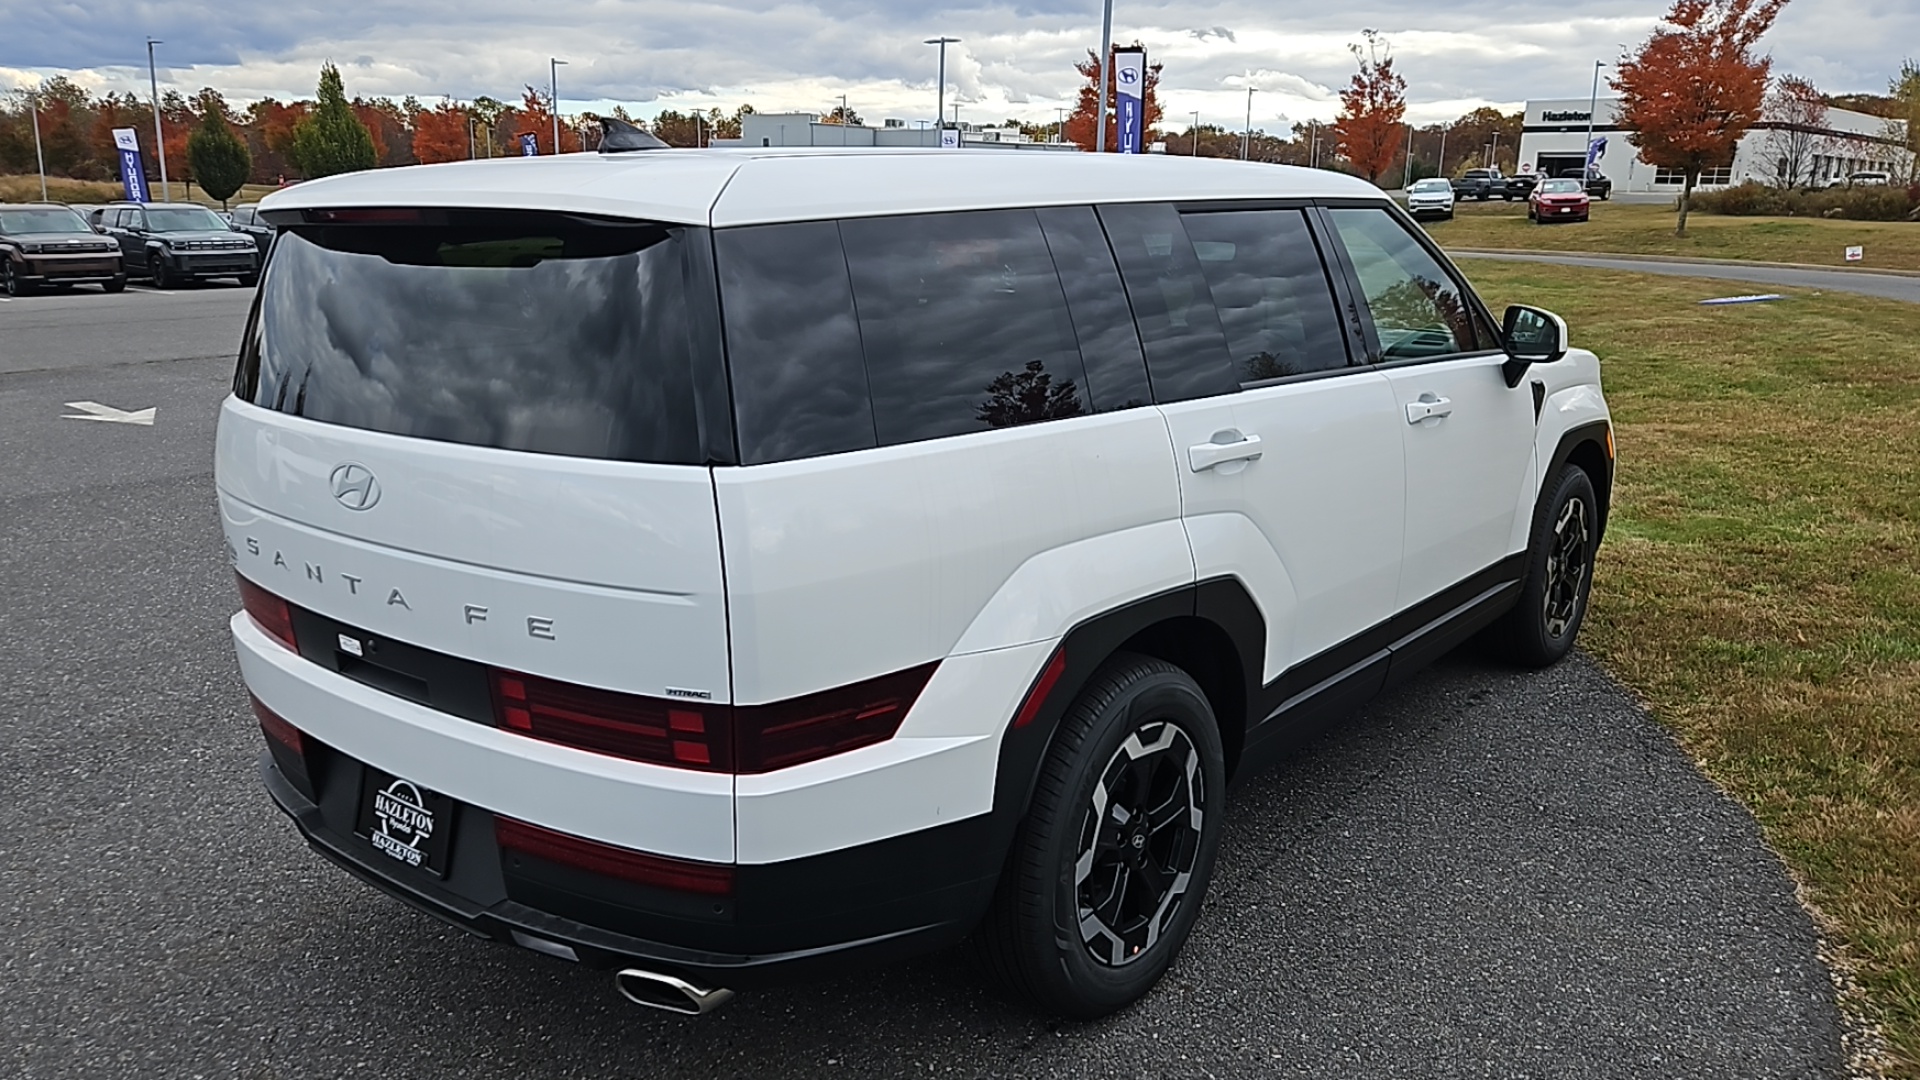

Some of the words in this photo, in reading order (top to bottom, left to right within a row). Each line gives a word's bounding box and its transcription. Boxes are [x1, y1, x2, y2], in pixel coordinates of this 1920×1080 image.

[1124, 102, 1133, 154] HYU
[246, 535, 412, 611] SANTA
[464, 604, 556, 641] FE
[375, 794, 434, 833] HAZLETON
[372, 832, 422, 864] HAZLETON
